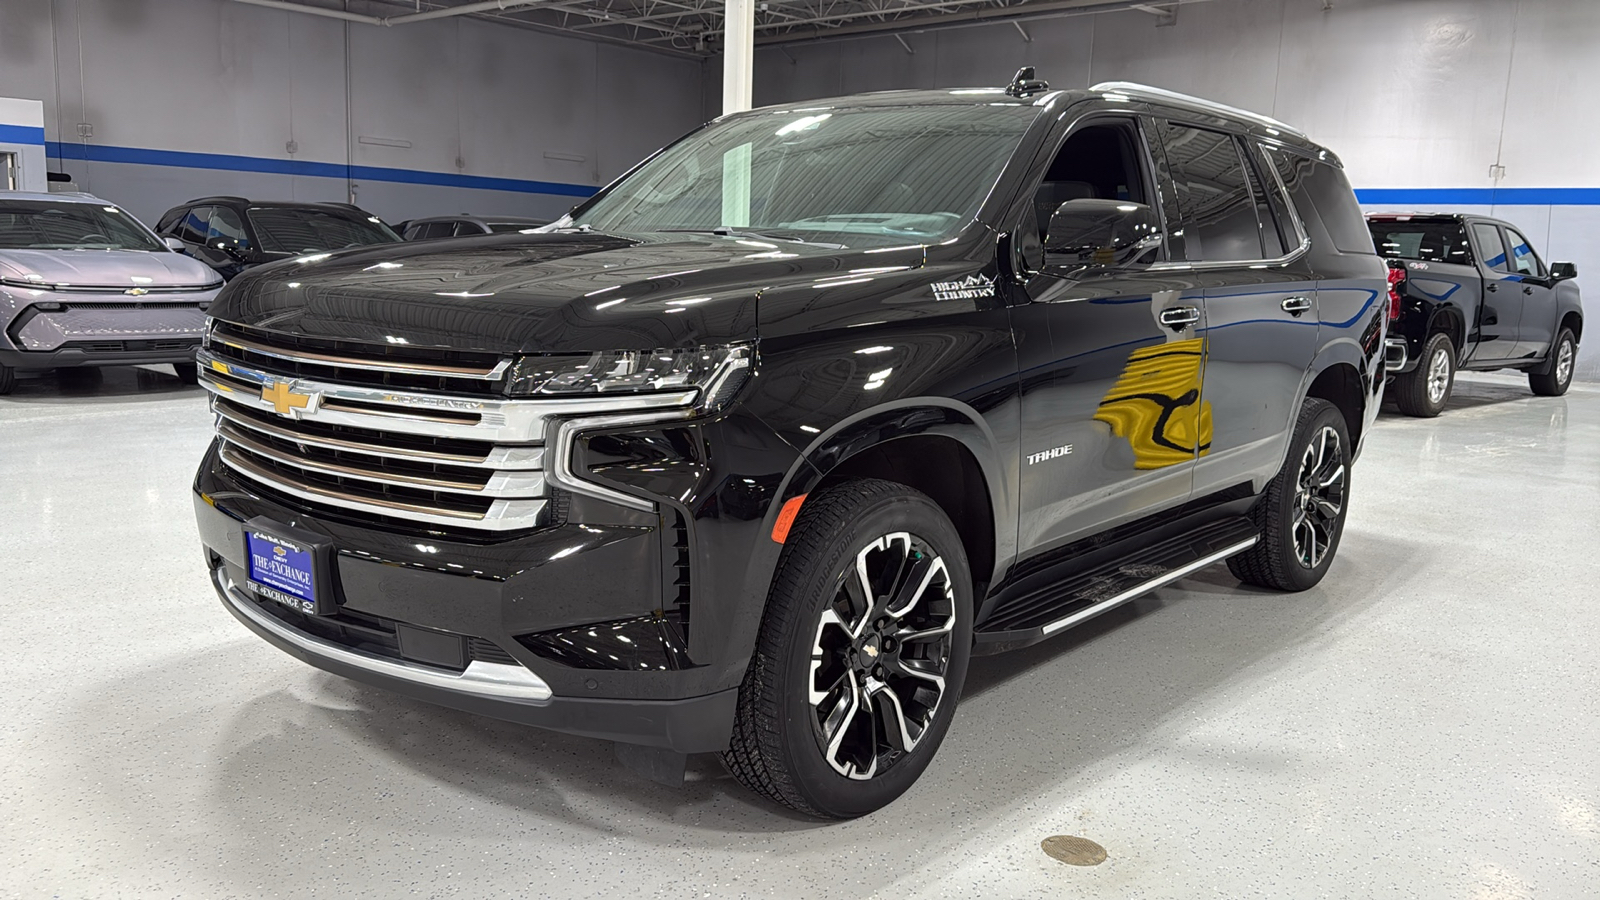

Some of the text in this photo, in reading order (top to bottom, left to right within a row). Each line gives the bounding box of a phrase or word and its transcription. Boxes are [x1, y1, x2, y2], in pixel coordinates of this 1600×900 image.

[930, 281, 965, 292] HIGH
[934, 288, 995, 301] COUNTRY
[1026, 444, 1073, 466] TAHOE
[253, 554, 311, 585] THE EXCHANGE
[273, 555, 288, 564] CHEVY
[805, 529, 858, 614] BRIDGESTONE
[246, 580, 300, 609] THE EXCHANGE
